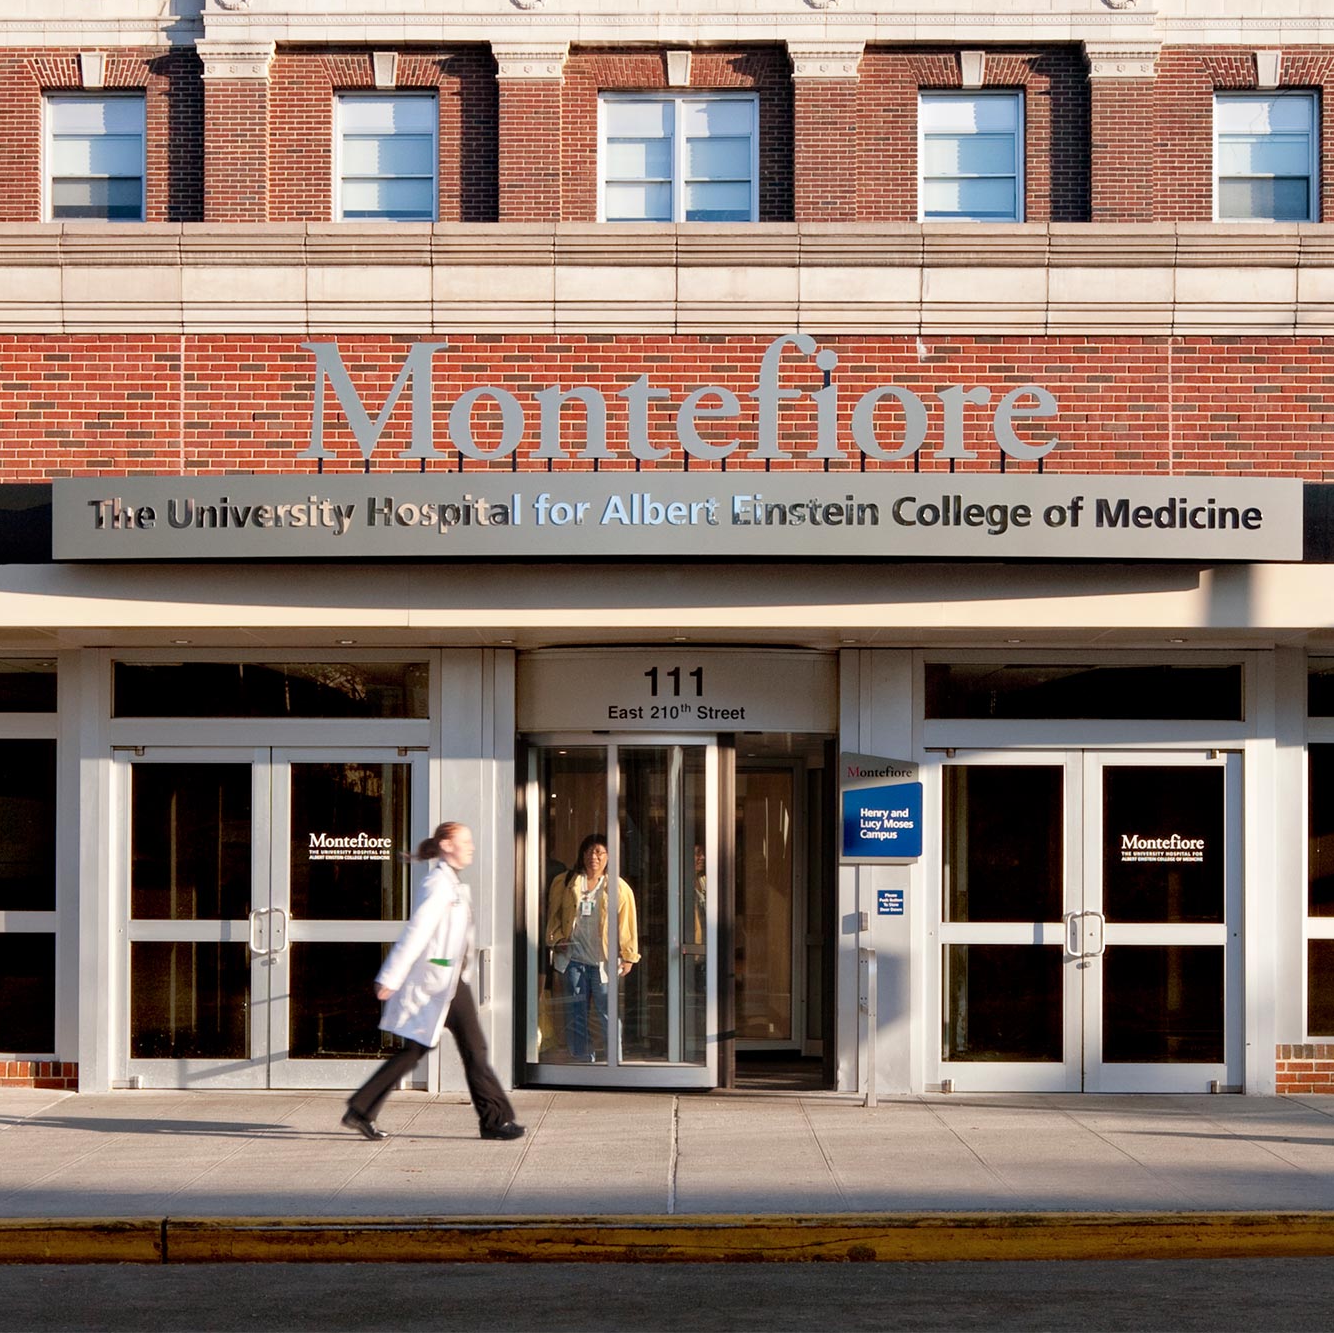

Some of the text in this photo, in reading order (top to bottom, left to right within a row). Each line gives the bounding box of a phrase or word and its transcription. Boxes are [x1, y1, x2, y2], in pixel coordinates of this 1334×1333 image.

[297, 333, 1059, 462] Montefiore
[87, 493, 1263, 536] The University Hospital for Albert Einstein College of Medicine
[644, 666, 703, 696] 111
[608, 703, 745, 719] East 210th Street
[848, 766, 913, 777] Montefiore
[860, 808, 909, 820] Henry and
[860, 819, 914, 830] Lucy Moses
[309, 832, 392, 848] Montefiore
[860, 829, 898, 841] Campus
[1121, 833, 1205, 850] Montefiore
